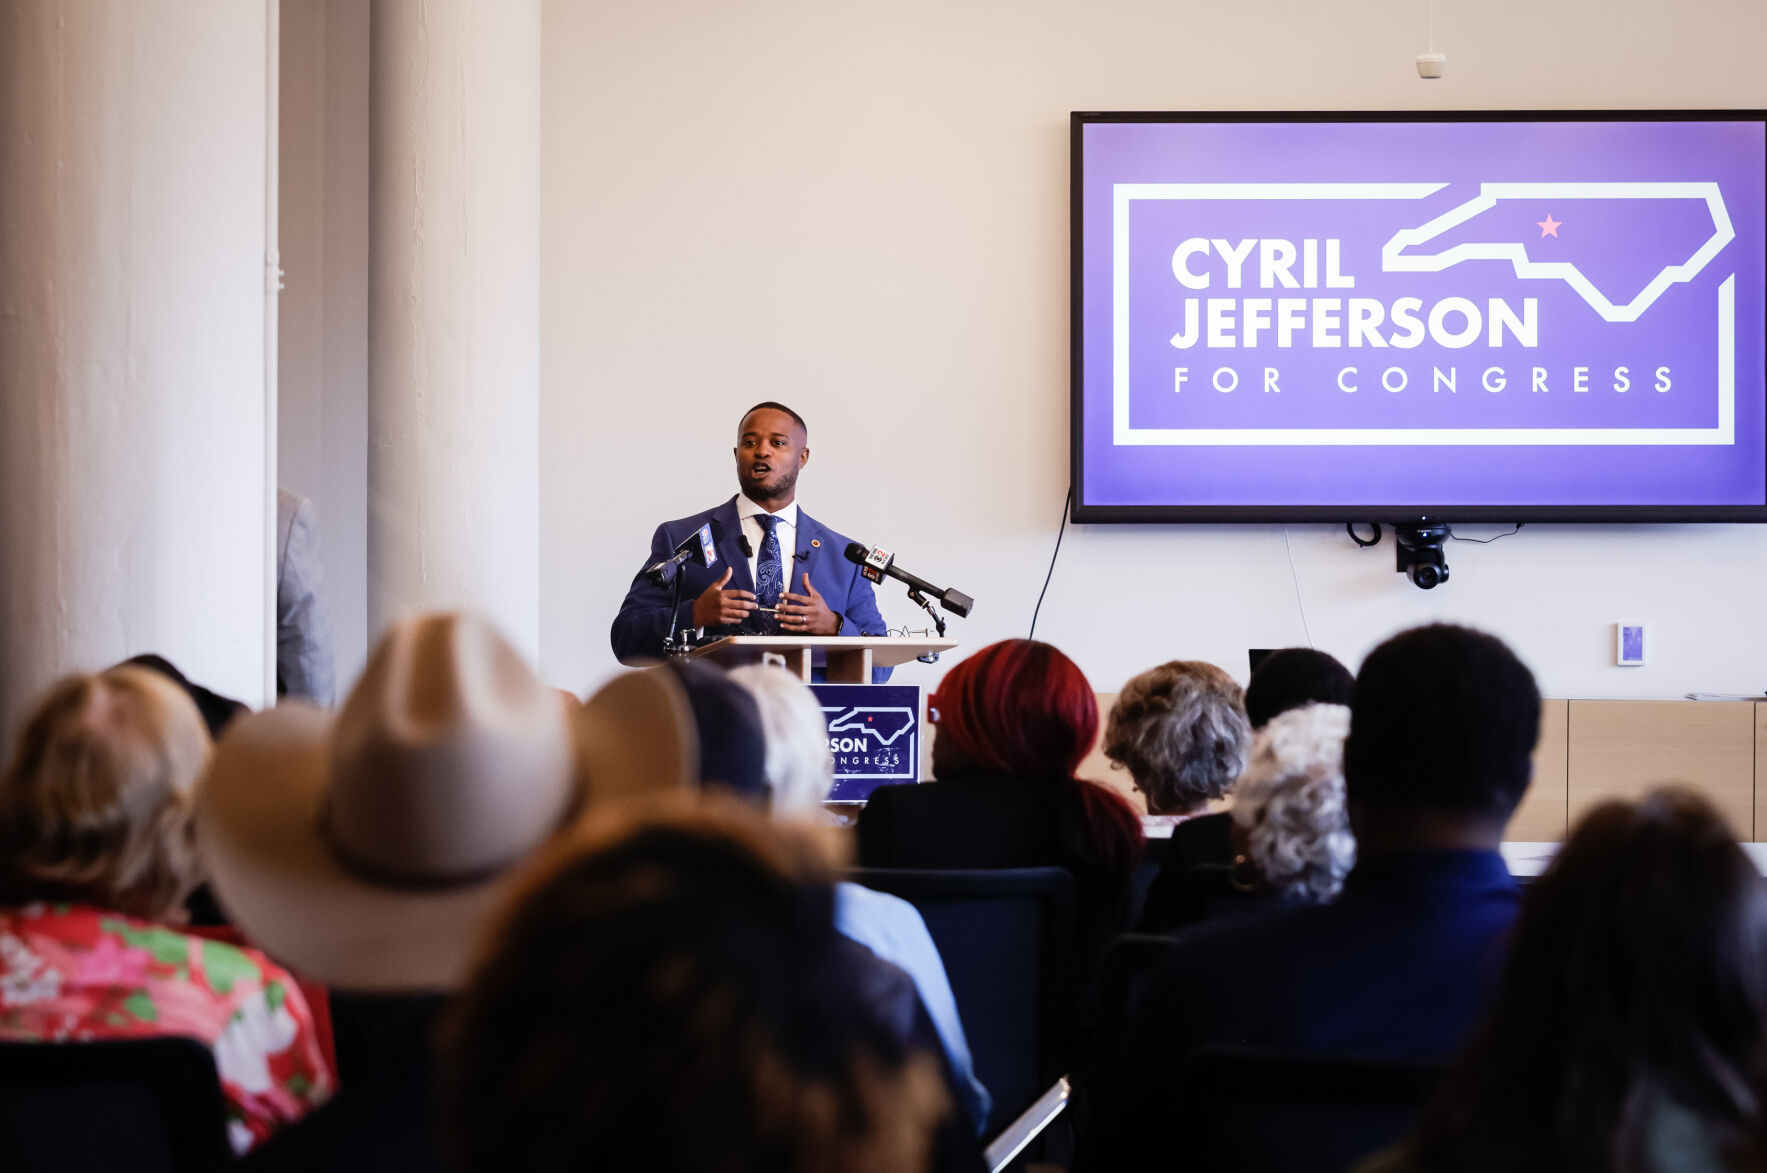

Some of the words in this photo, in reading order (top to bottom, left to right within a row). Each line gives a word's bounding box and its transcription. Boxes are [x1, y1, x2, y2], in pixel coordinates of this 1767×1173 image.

[1171, 237, 1356, 290] CYRIL
[1169, 296, 1539, 350] JEFFERSON
[1174, 367, 1281, 394] FOR
[1337, 366, 1673, 394] CONGRESS
